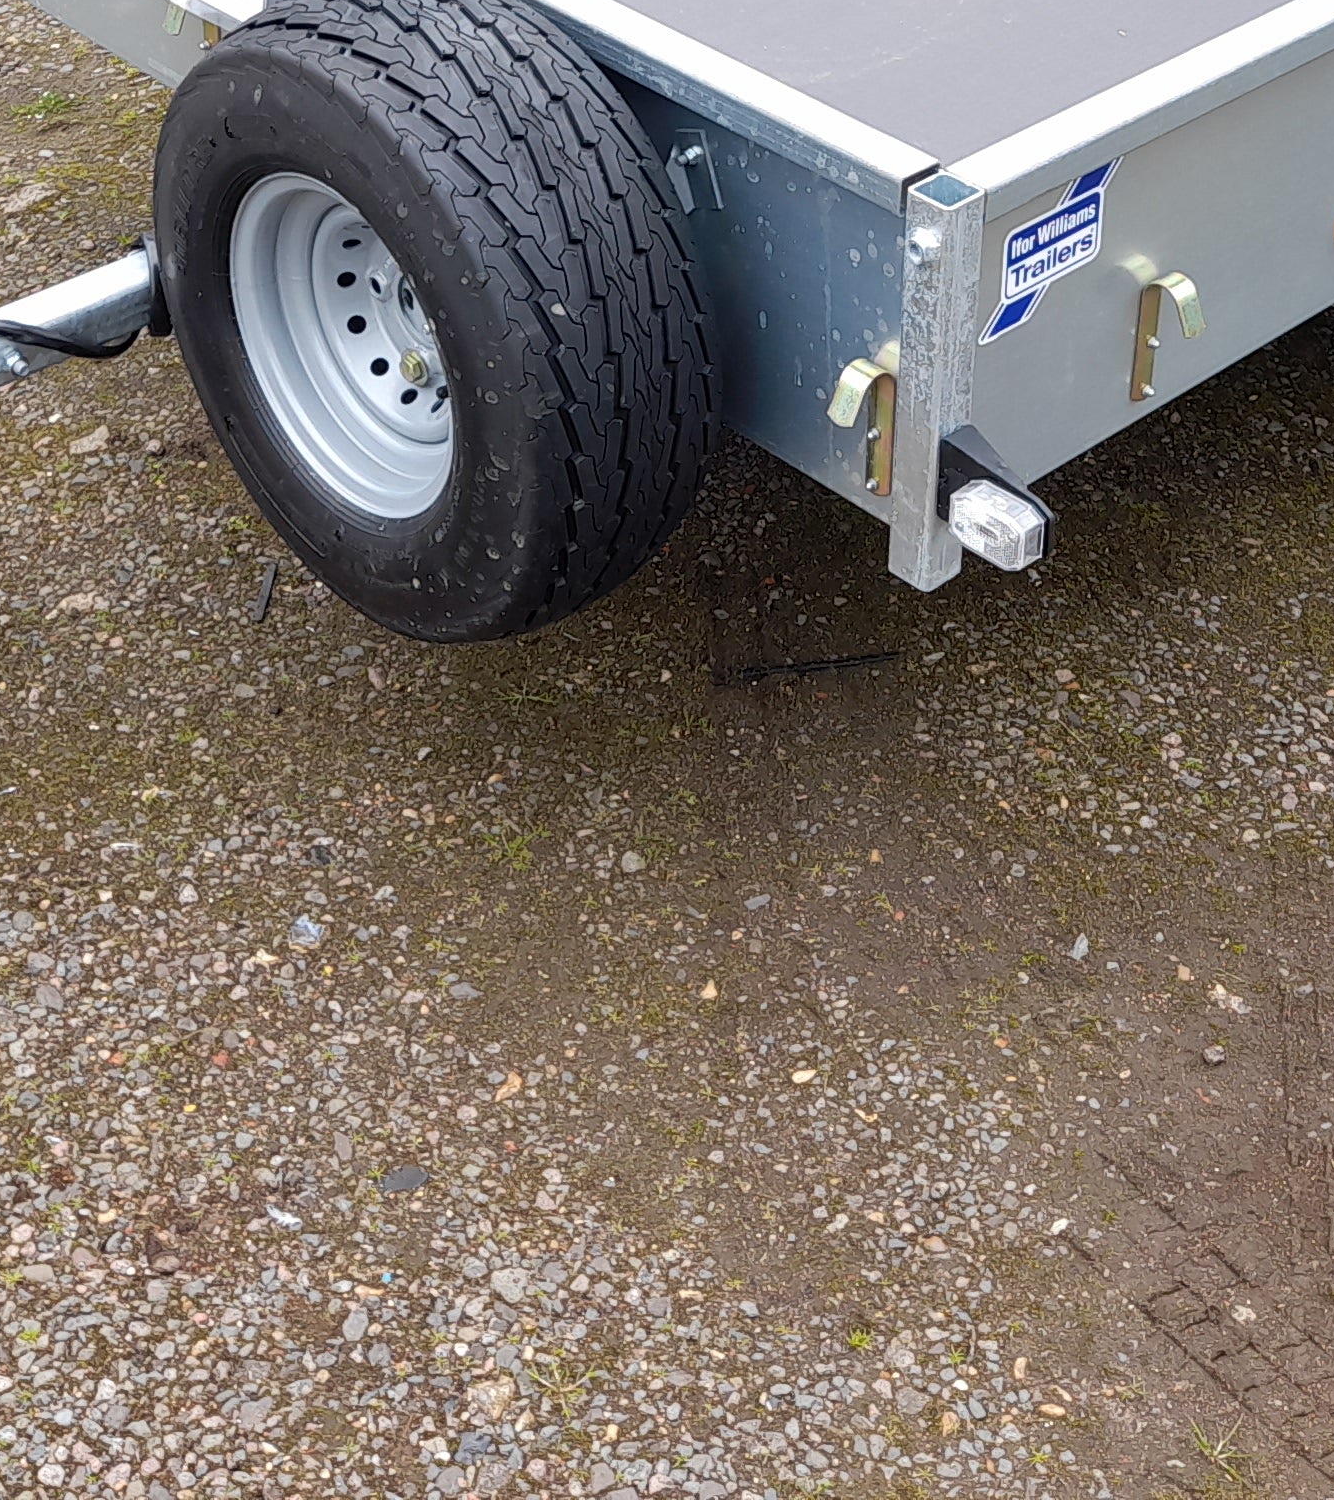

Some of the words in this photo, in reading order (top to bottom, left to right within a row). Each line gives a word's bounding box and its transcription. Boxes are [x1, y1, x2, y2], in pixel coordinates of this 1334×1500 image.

[1011, 235, 1035, 260] Ifor
[1037, 203, 1096, 247] Williams
[1010, 232, 1094, 288] Trailers
